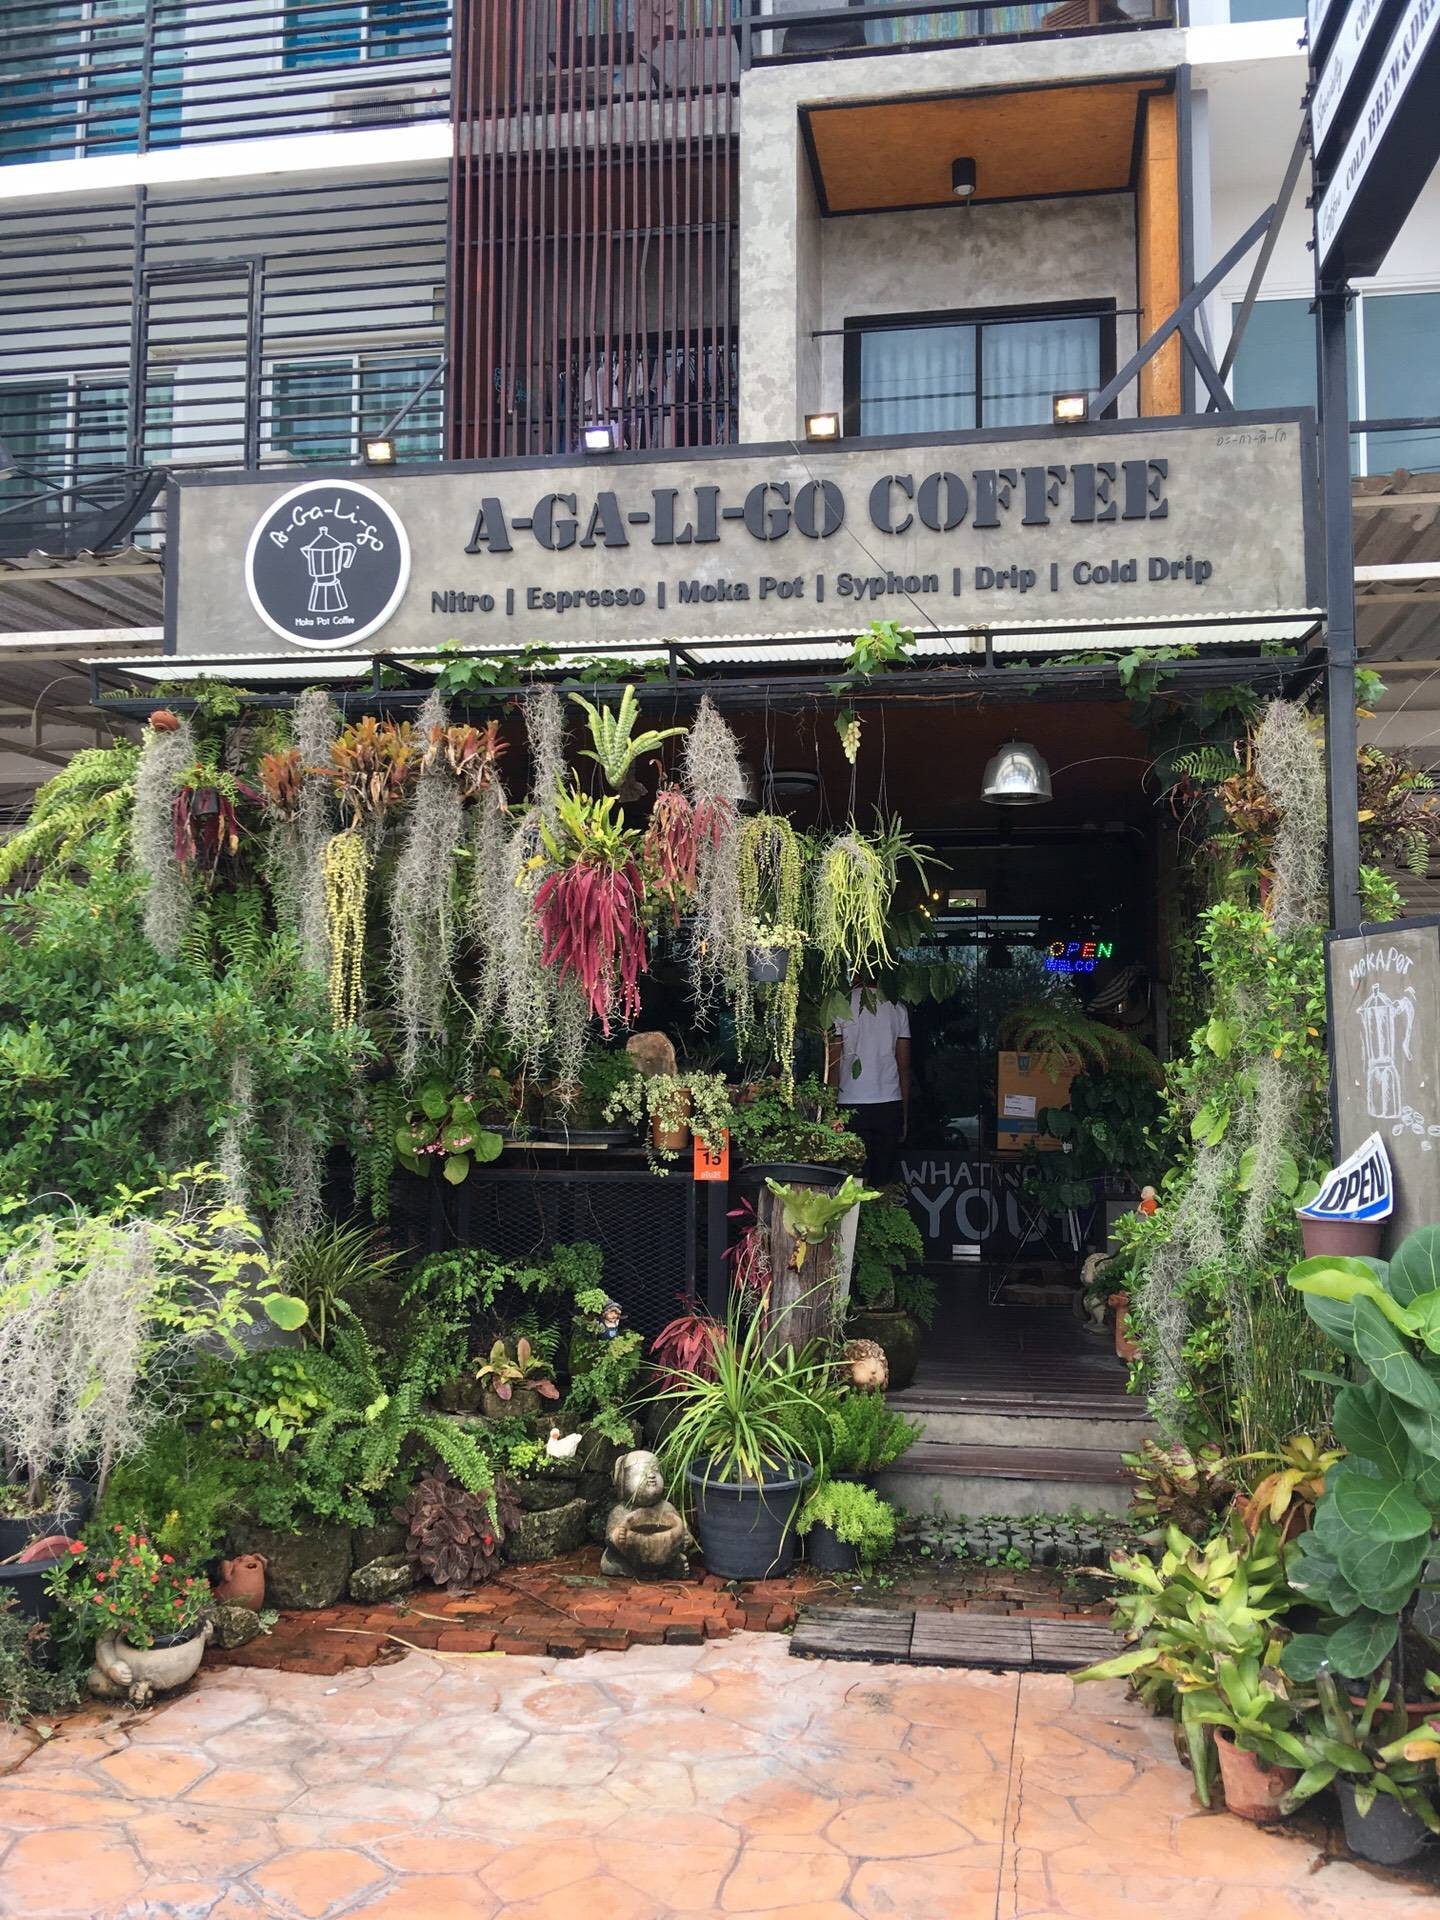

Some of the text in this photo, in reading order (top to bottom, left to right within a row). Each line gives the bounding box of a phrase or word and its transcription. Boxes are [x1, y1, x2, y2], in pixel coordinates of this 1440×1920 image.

[1346, 136, 1366, 191] COLD
[464, 458, 1168, 554] A-GA-LI-GO COFFEE
[431, 590, 495, 613] Nitro
[527, 585, 646, 613] Espresso
[678, 578, 750, 604] Moka
[759, 576, 804, 600] Pot
[836, 570, 939, 600] Syphon
[975, 564, 1036, 593] Drip
[1073, 558, 1137, 584] Cold
[1148, 555, 1213, 584] Drip
[316, 616, 331, 627] Pot
[332, 615, 355, 626] Coffee
[1049, 940, 1113, 959] OPEN
[901, 1159, 991, 1187] WHAT
[1319, 1150, 1386, 1213] OPEN
